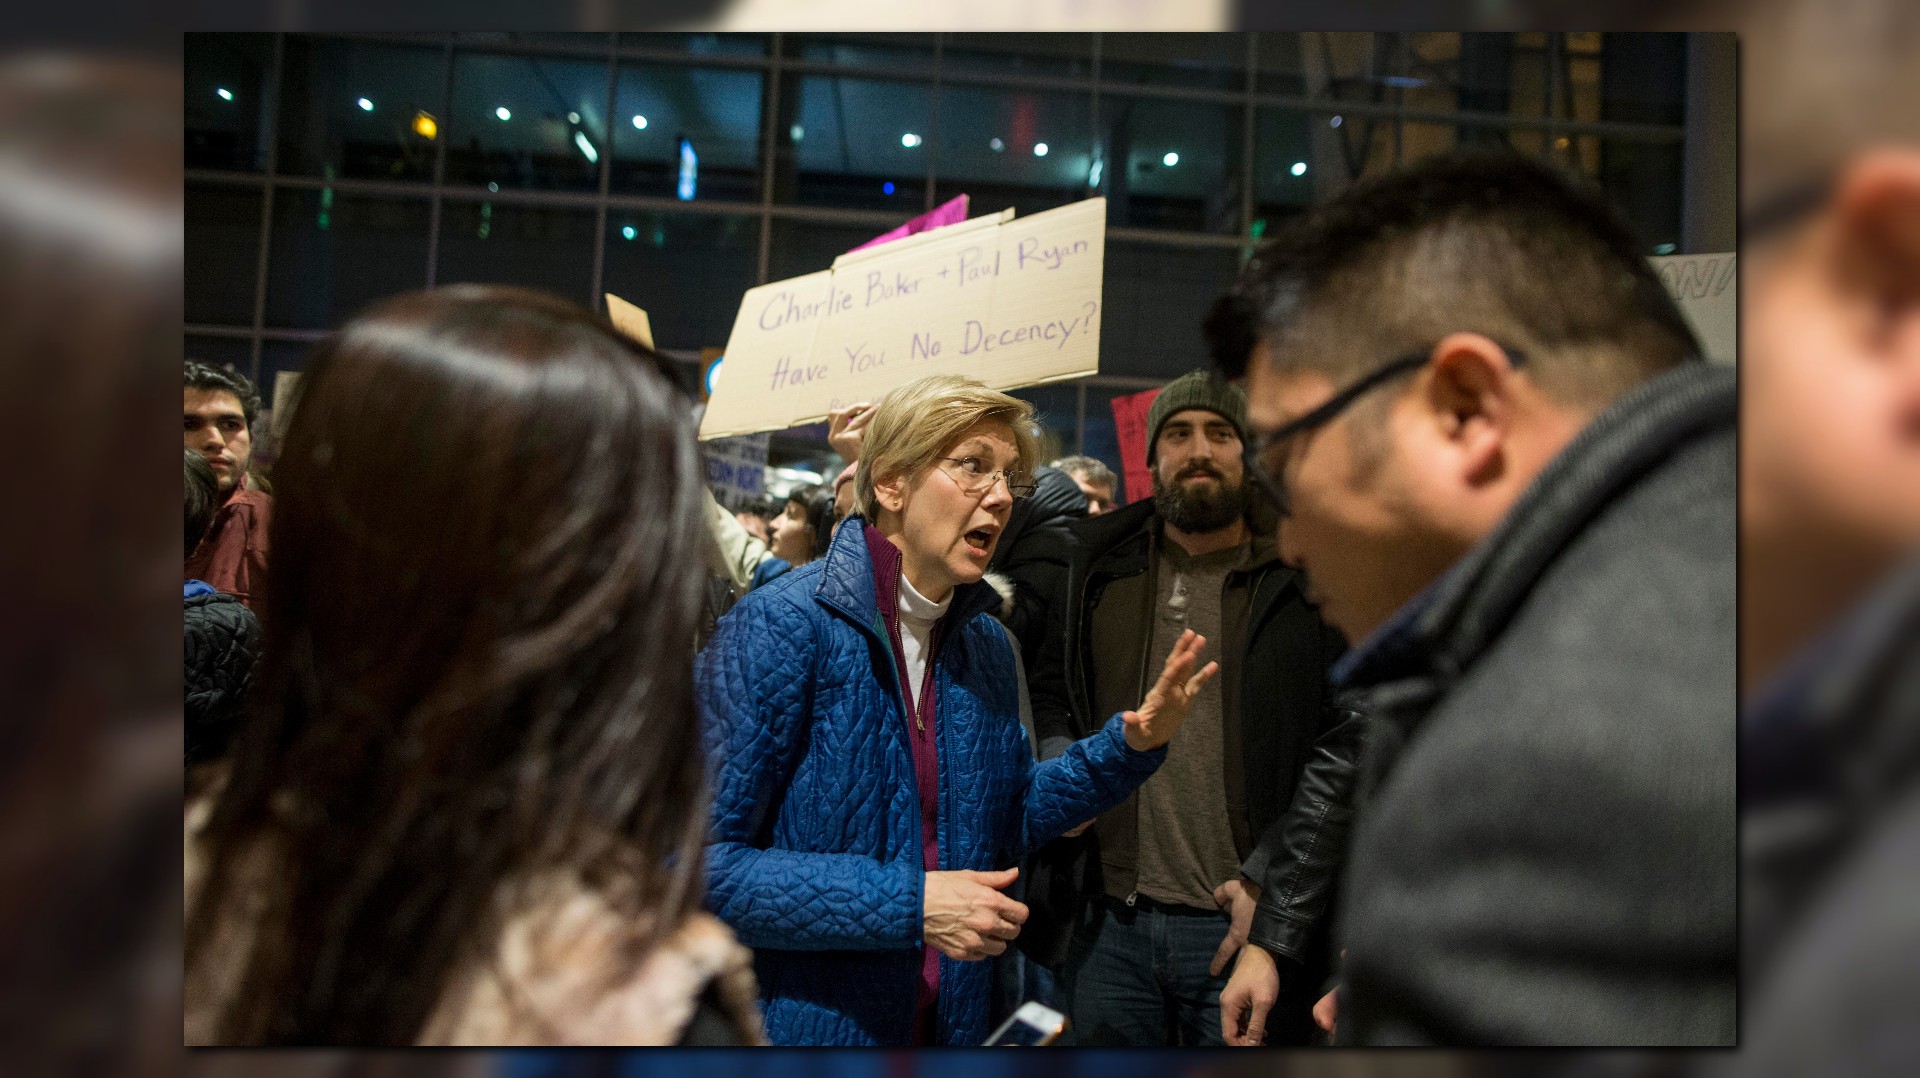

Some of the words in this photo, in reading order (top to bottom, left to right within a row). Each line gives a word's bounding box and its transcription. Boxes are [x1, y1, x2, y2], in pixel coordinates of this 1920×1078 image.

[758, 286, 854, 332] Charlie
[864, 268, 922, 308] Baker
[937, 265, 952, 280] +
[957, 245, 1001, 288] Paul
[1018, 236, 1089, 271] Ryan
[770, 357, 829, 392] Have
[845, 341, 886, 375] You
[910, 332, 942, 361] No
[959, 300, 1098, 357] Decency?
